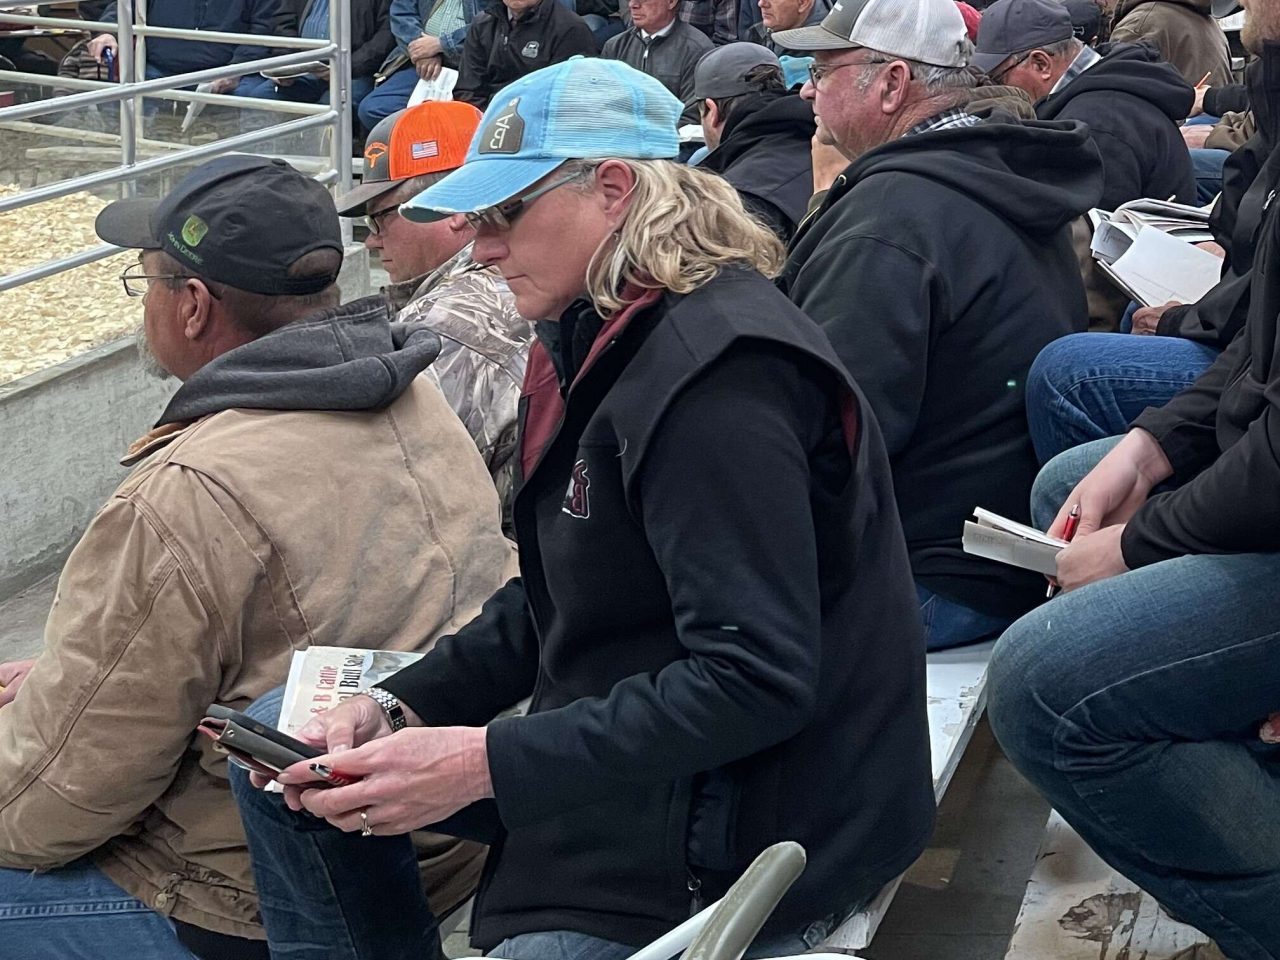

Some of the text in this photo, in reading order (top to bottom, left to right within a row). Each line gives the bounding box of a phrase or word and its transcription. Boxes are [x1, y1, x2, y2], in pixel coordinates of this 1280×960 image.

[344, 653, 366, 668] Sale
[315, 665, 339, 690] Cattle
[338, 670, 362, 689] Bull
